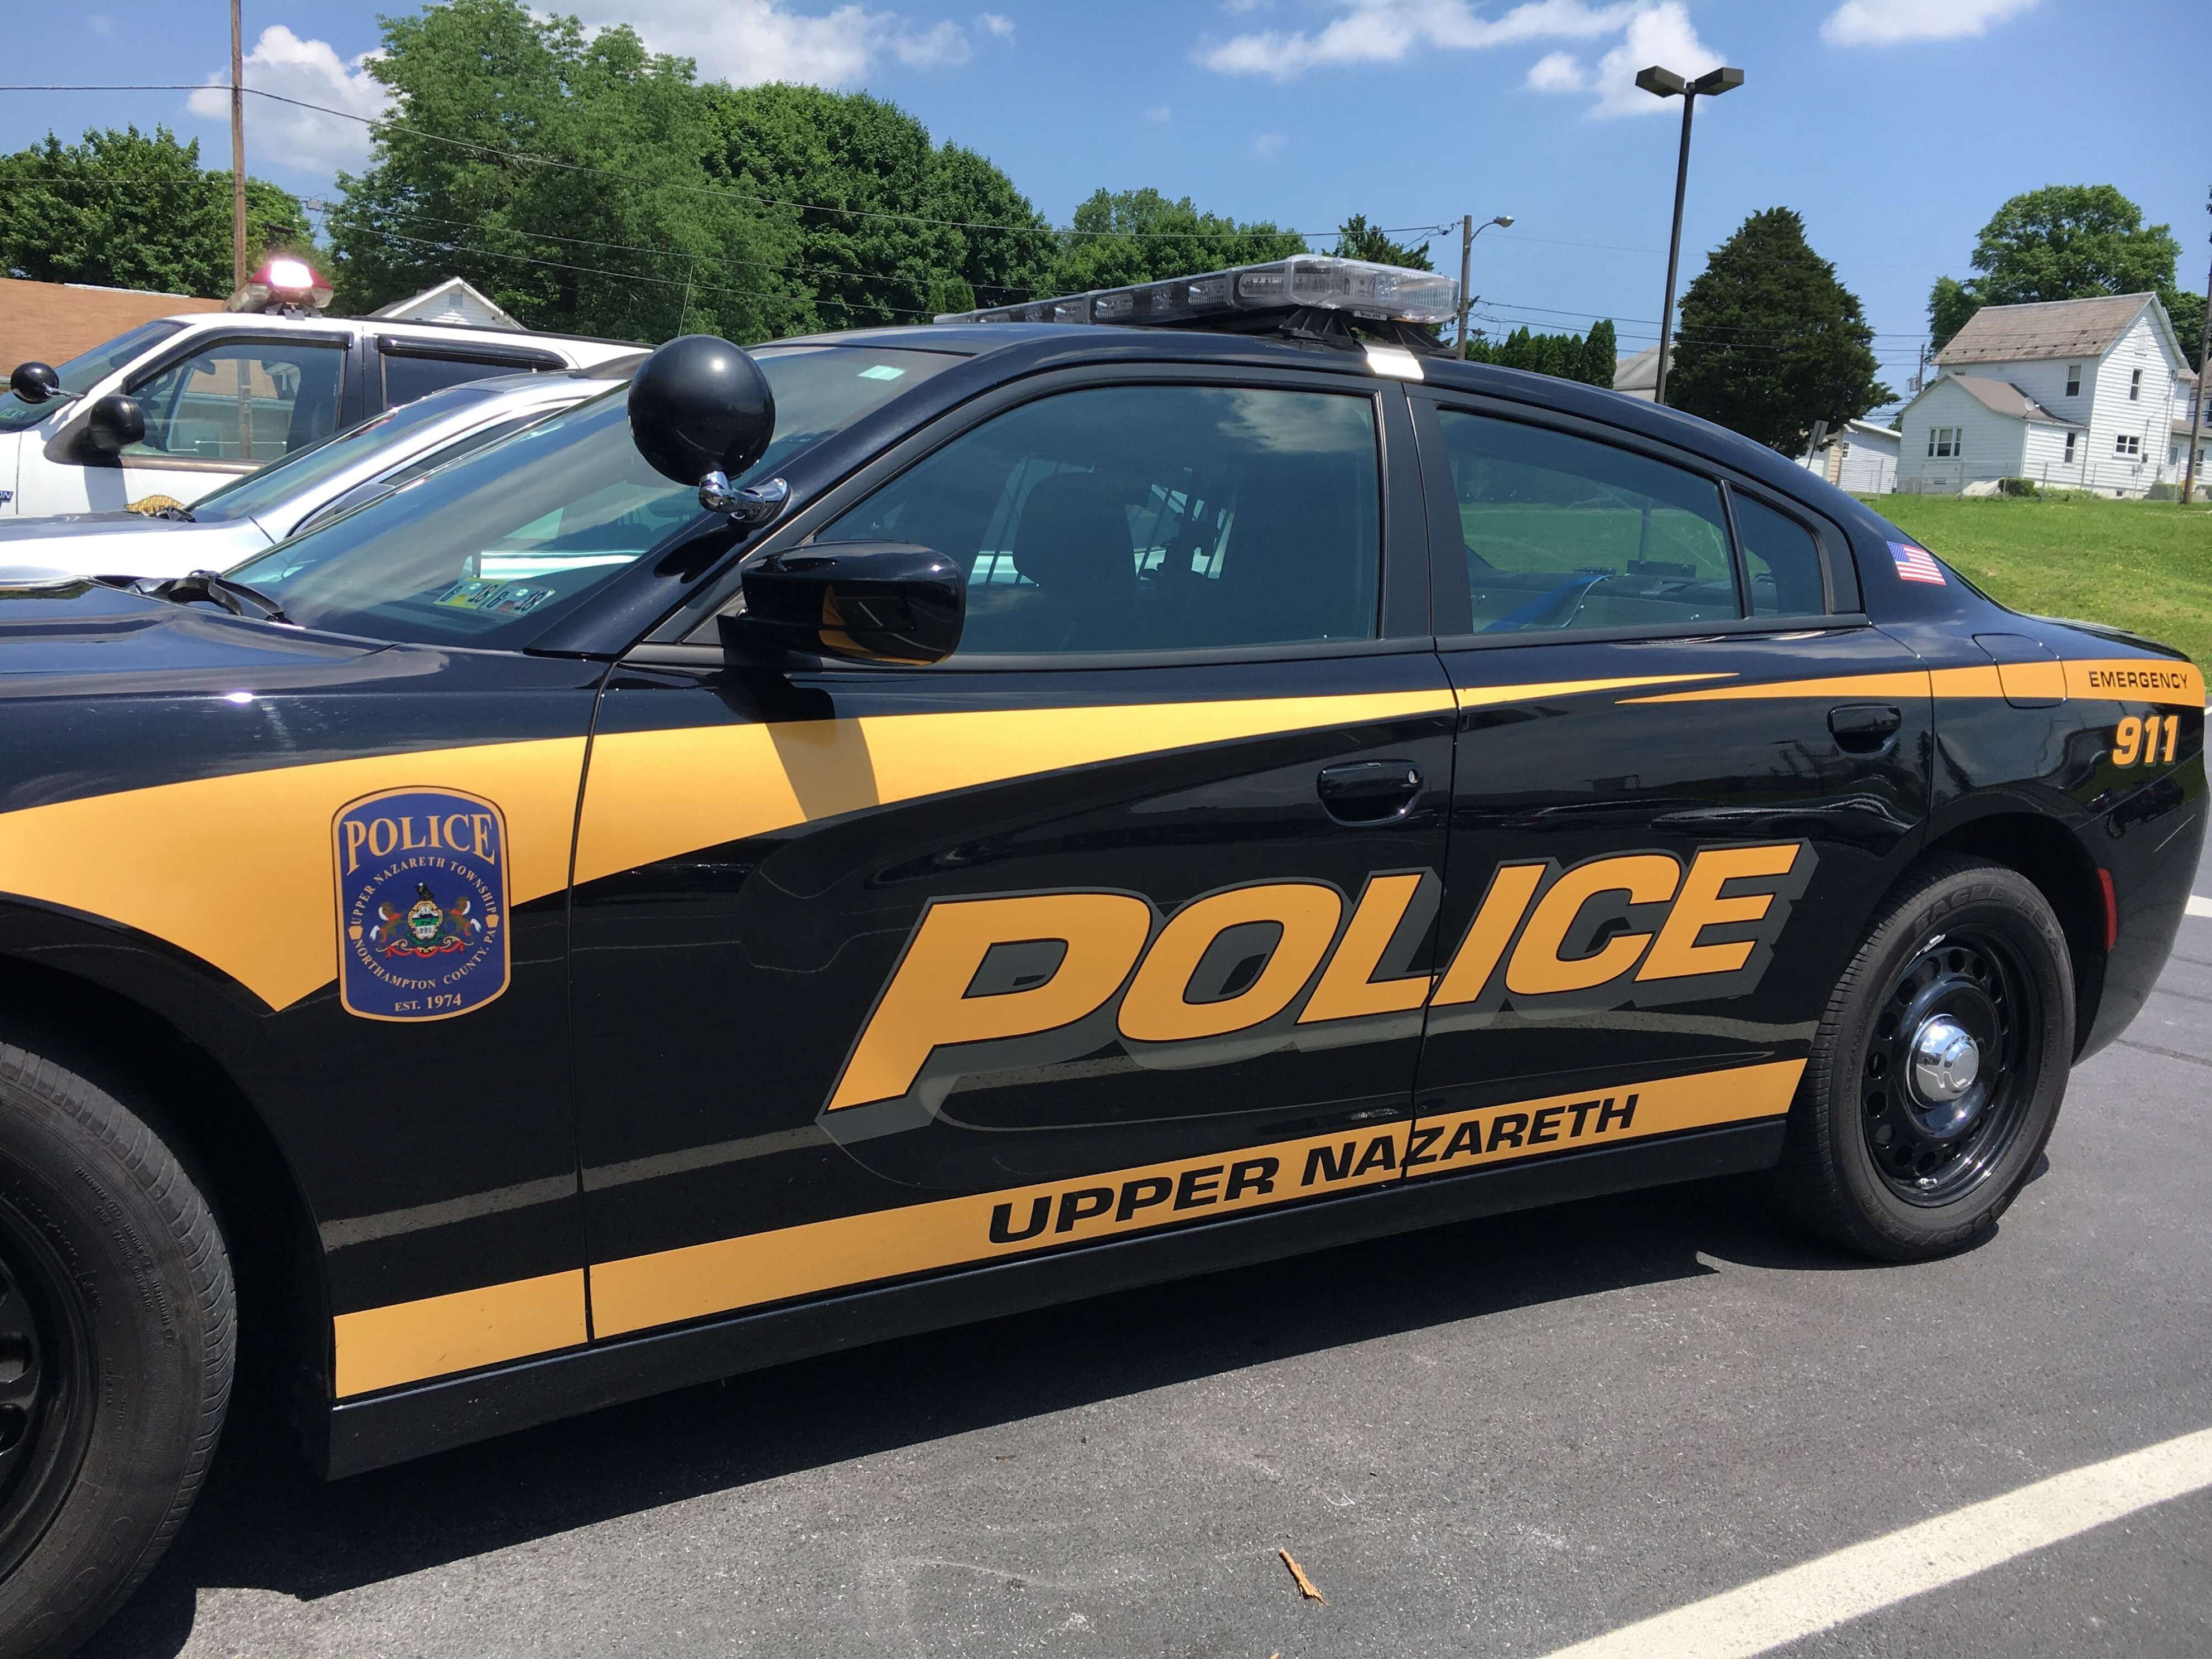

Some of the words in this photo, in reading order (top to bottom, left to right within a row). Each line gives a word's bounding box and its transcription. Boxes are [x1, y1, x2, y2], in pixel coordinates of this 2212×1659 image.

[2088, 671, 2187, 689] EMERGENCY
[2112, 715, 2180, 766] 911
[343, 814, 495, 876] POLICE
[351, 885, 375, 925] UPPER
[373, 856, 446, 885] NAZARETH
[450, 861, 497, 914] TOWNSHIP
[1915, 885, 2006, 937] EAGLE
[353, 939, 436, 990] NORTHAMPTON
[483, 930, 496, 943] PA
[825, 843, 1805, 1113] POLICE
[394, 1000, 421, 1012] EST.
[426, 994, 462, 1009] 1974
[987, 1155, 1280, 1246] UPPER
[1299, 1093, 1638, 1189] NAZARETH
